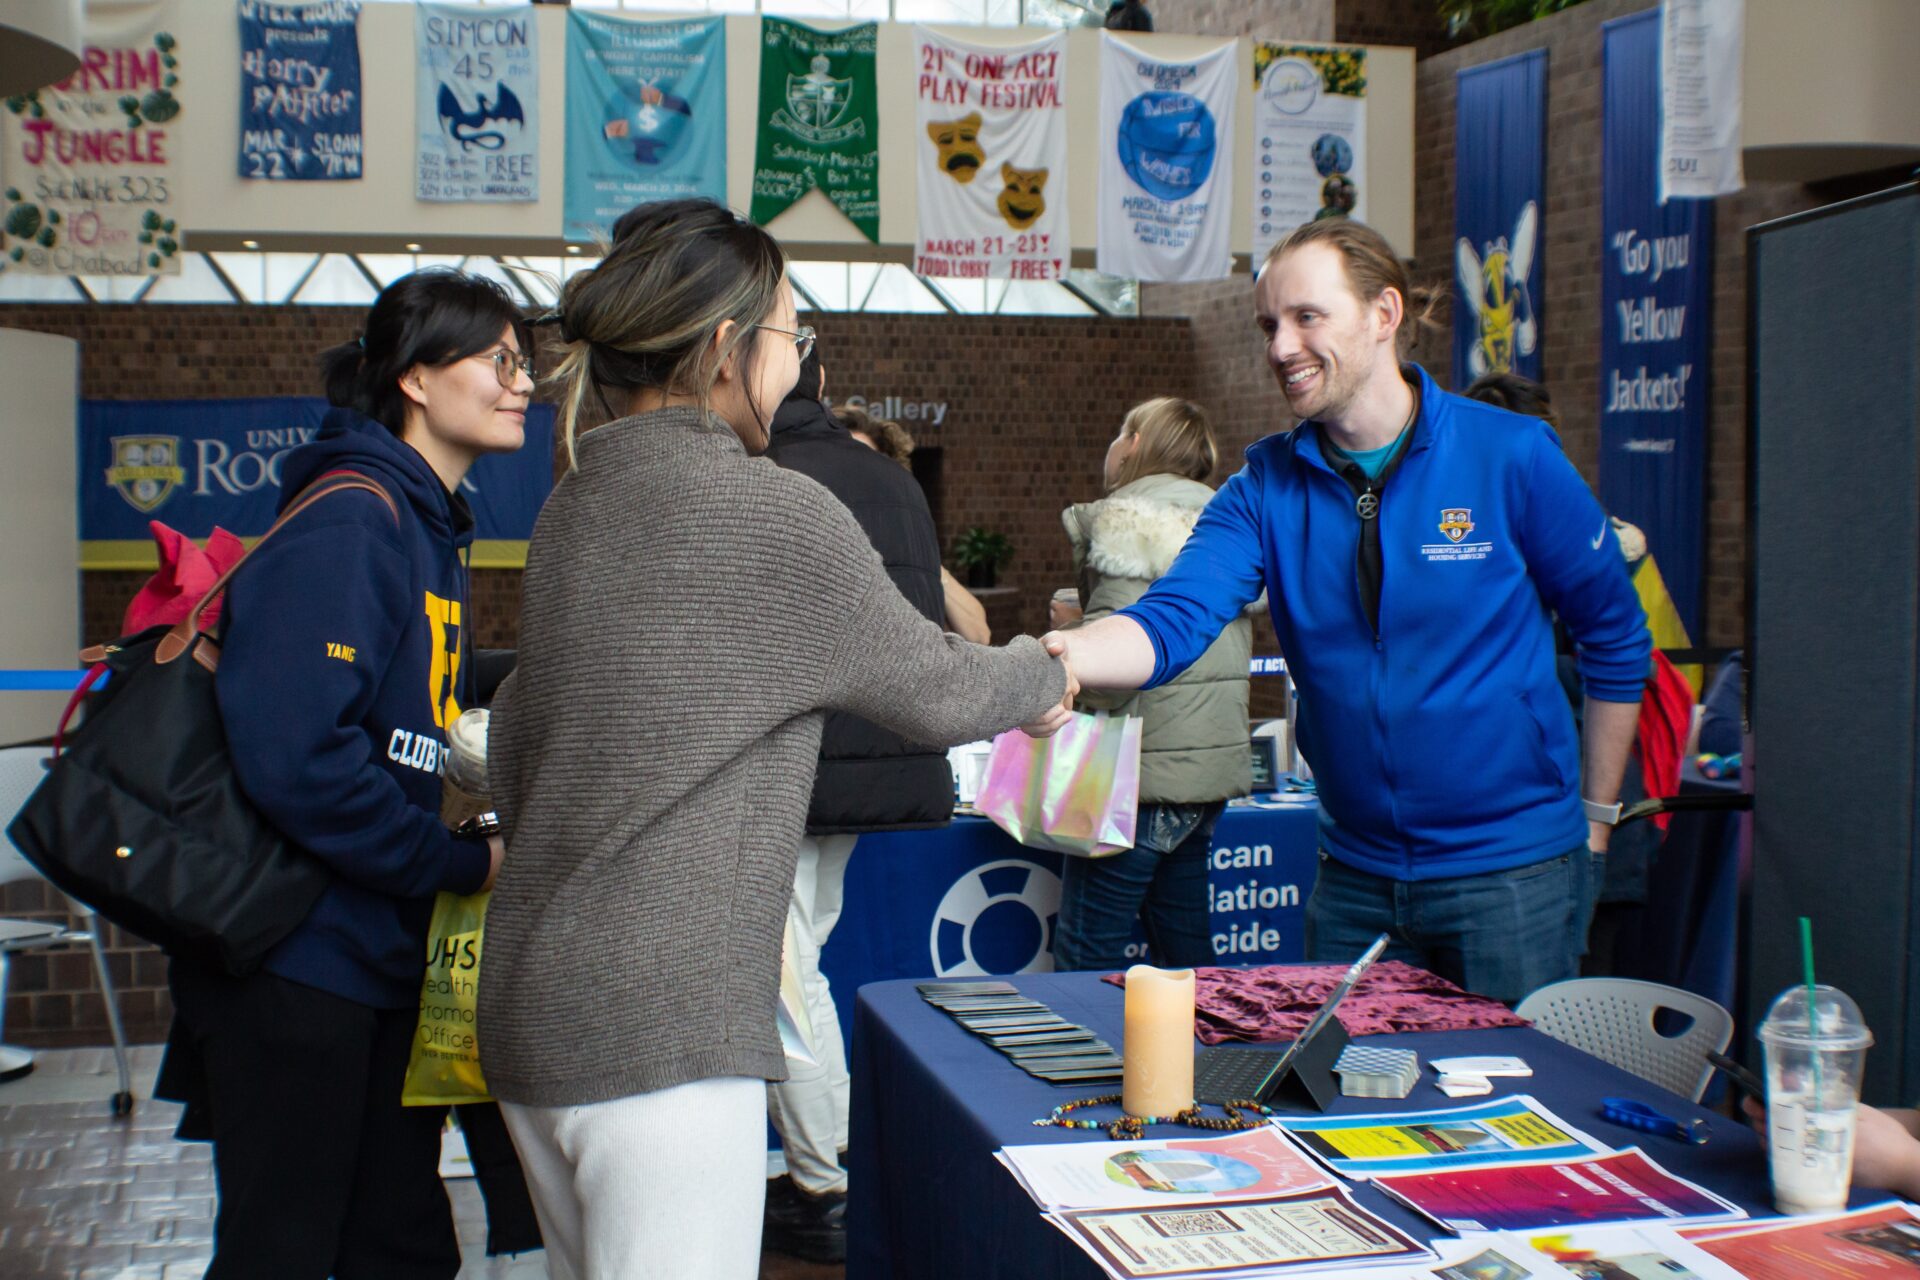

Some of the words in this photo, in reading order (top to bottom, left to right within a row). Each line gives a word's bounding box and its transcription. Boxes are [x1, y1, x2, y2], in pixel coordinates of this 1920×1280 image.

[427, 16, 526, 48] SIMCON
[64, 46, 160, 92] RIM
[243, 48, 330, 92] Harry
[453, 52, 494, 79] 45
[642, 52, 705, 63] CAPITALISM
[607, 66, 636, 76] HERE
[639, 67, 652, 76] TO
[919, 73, 968, 105] PLAY
[981, 80, 1062, 109] FESTIVAL
[22, 119, 167, 165] JUNGLE
[244, 129, 286, 153] MAR
[312, 132, 361, 156] SLOAN
[248, 152, 285, 177] 22
[485, 153, 533, 176] FREE
[926, 238, 975, 256] MARCH
[1650, 233, 1690, 283] you
[53, 247, 143, 274] Chabad
[916, 255, 950, 278] TODD
[1010, 257, 1062, 280] FREE!
[1617, 296, 1686, 344] Yellow
[845, 395, 947, 425] Gallery
[1421, 547, 1462, 555] RESIDENTIAL
[1458, 553, 1487, 561] SERVICES
[326, 641, 357, 664] YANG
[387, 728, 439, 774] CLUB
[1212, 921, 1281, 955] cide
[418, 1024, 475, 1050] Office
